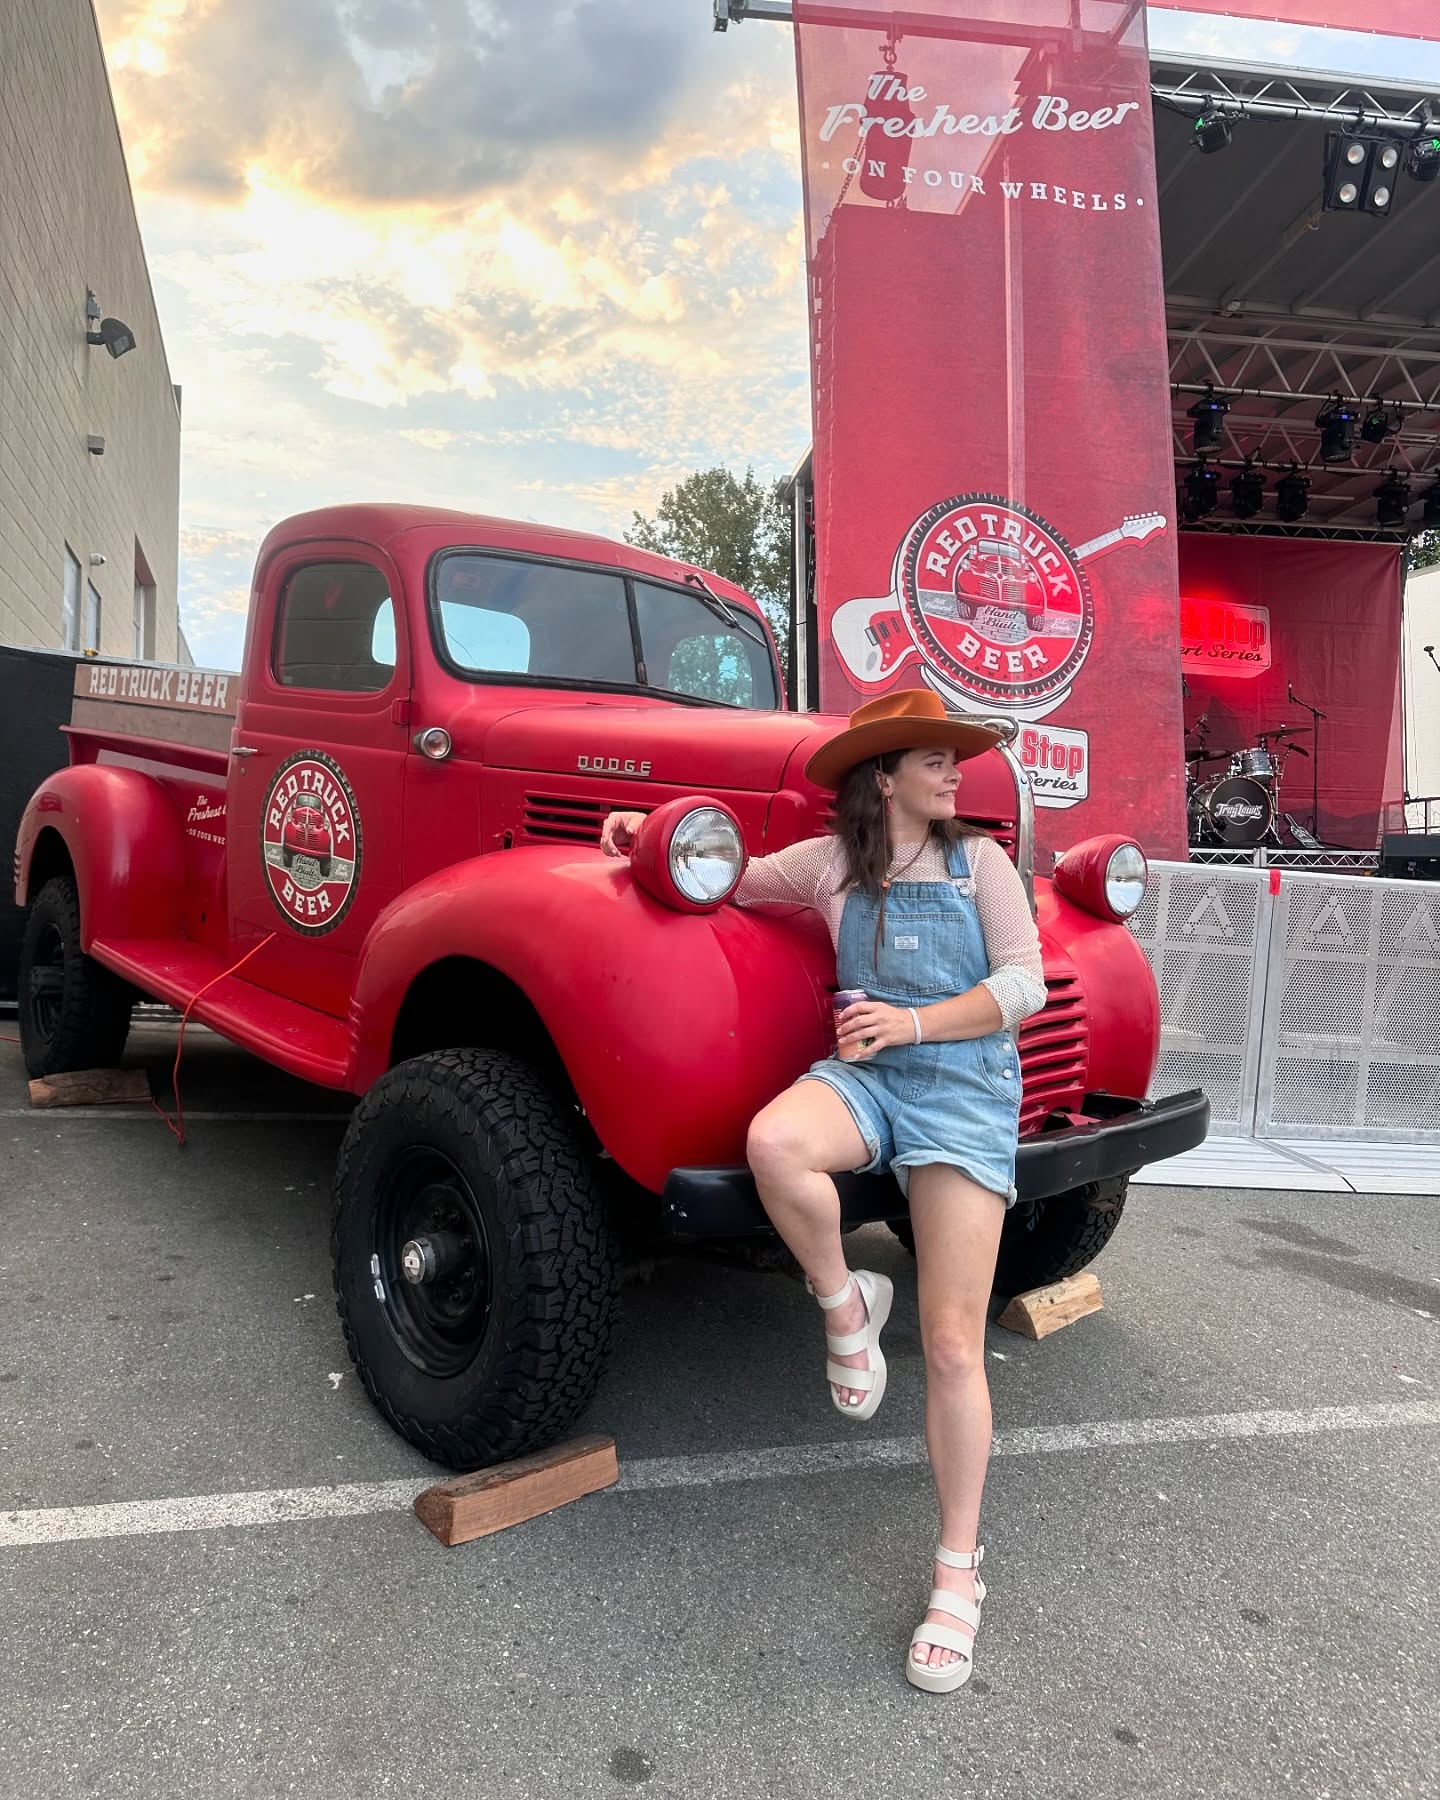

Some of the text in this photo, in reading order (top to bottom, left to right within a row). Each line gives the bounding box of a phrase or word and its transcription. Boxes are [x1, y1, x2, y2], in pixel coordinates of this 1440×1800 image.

[867, 74, 927, 102] The
[818, 95, 1140, 142] Freshest Beer
[842, 157, 1128, 211] ON FOUR WHEELS
[984, 605, 1019, 620] Hand
[985, 617, 1018, 630] Built
[957, 632, 1048, 673] BEER
[1207, 644, 1264, 662] Series
[90, 666, 229, 709] RED TRUCK BEER
[577, 755, 652, 775] DODGE
[1020, 729, 1084, 779] Stop
[282, 878, 332, 916] BEER
